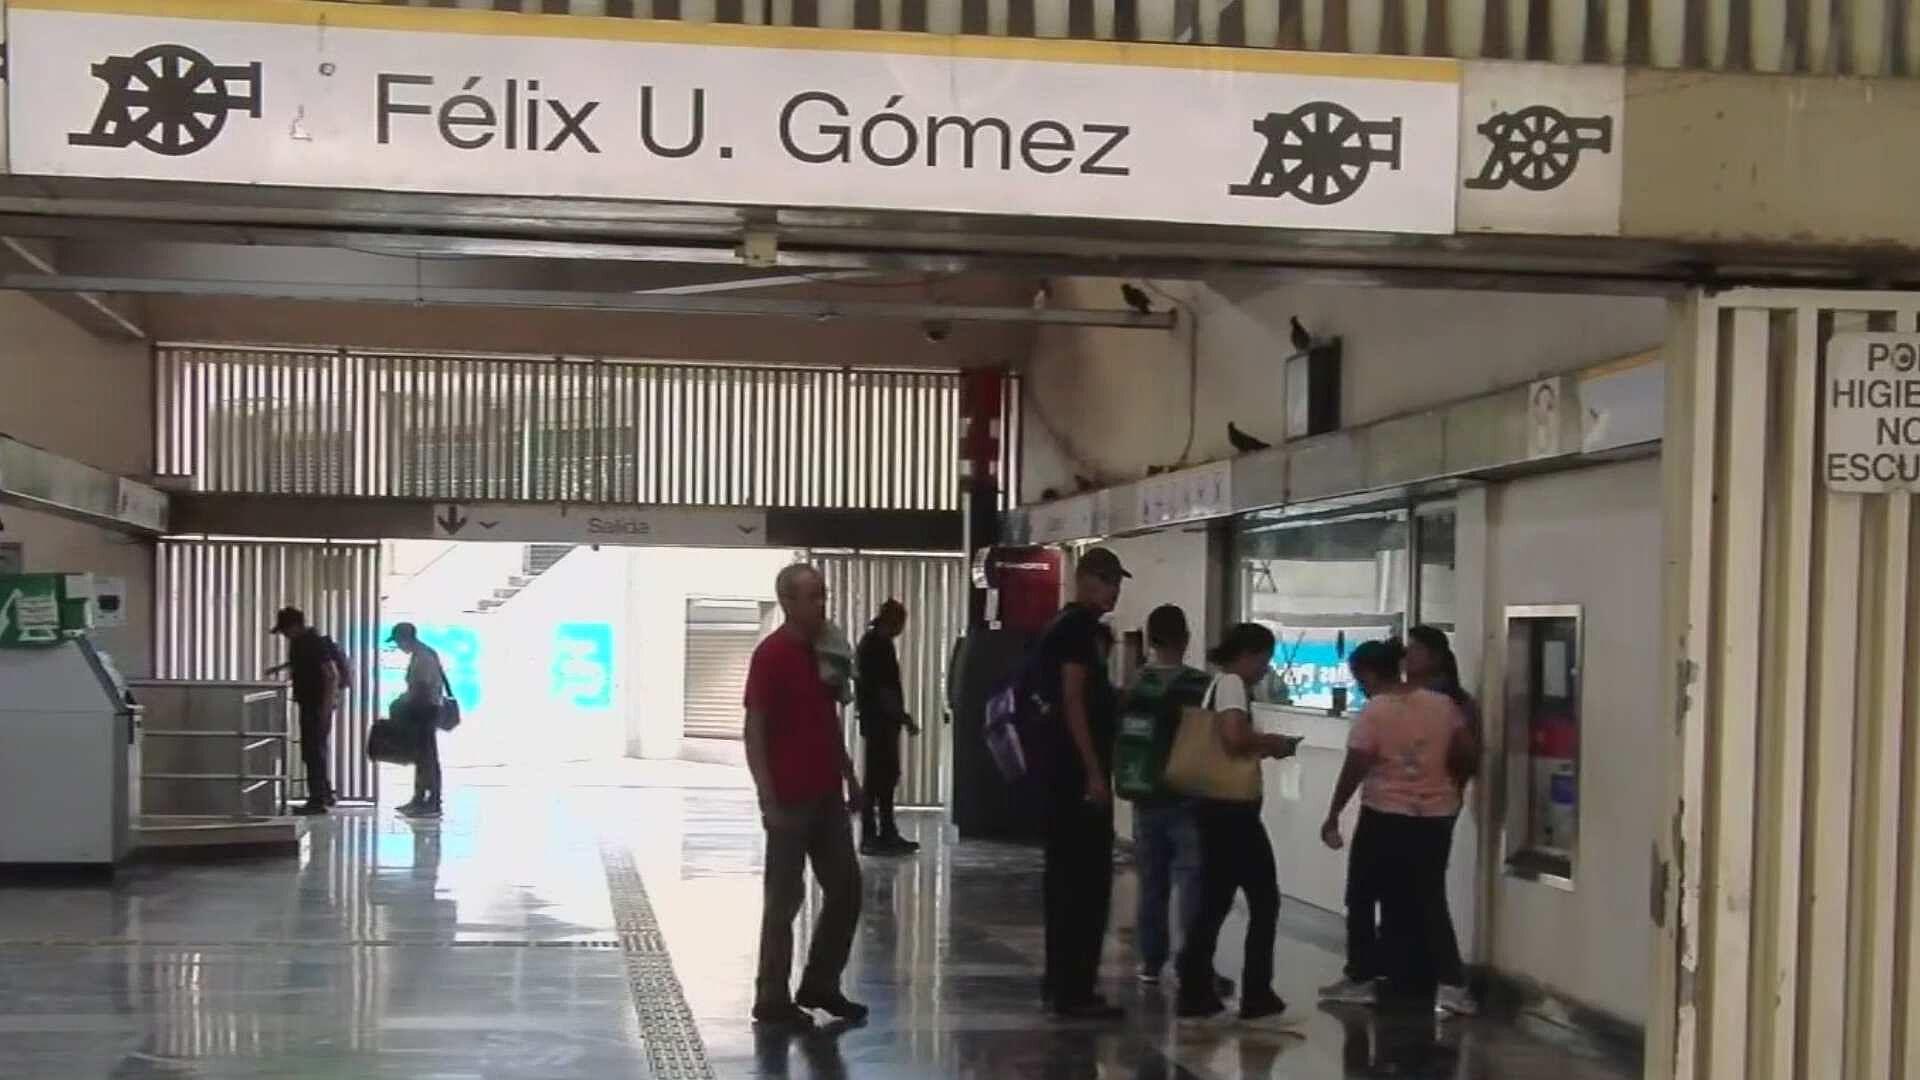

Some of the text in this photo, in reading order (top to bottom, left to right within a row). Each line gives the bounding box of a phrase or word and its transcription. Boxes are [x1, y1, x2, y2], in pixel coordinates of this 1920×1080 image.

[376, 73, 1130, 177] Félix U. Gómez
[1867, 342, 1920, 372] PO
[1827, 453, 1920, 482] ESCU
